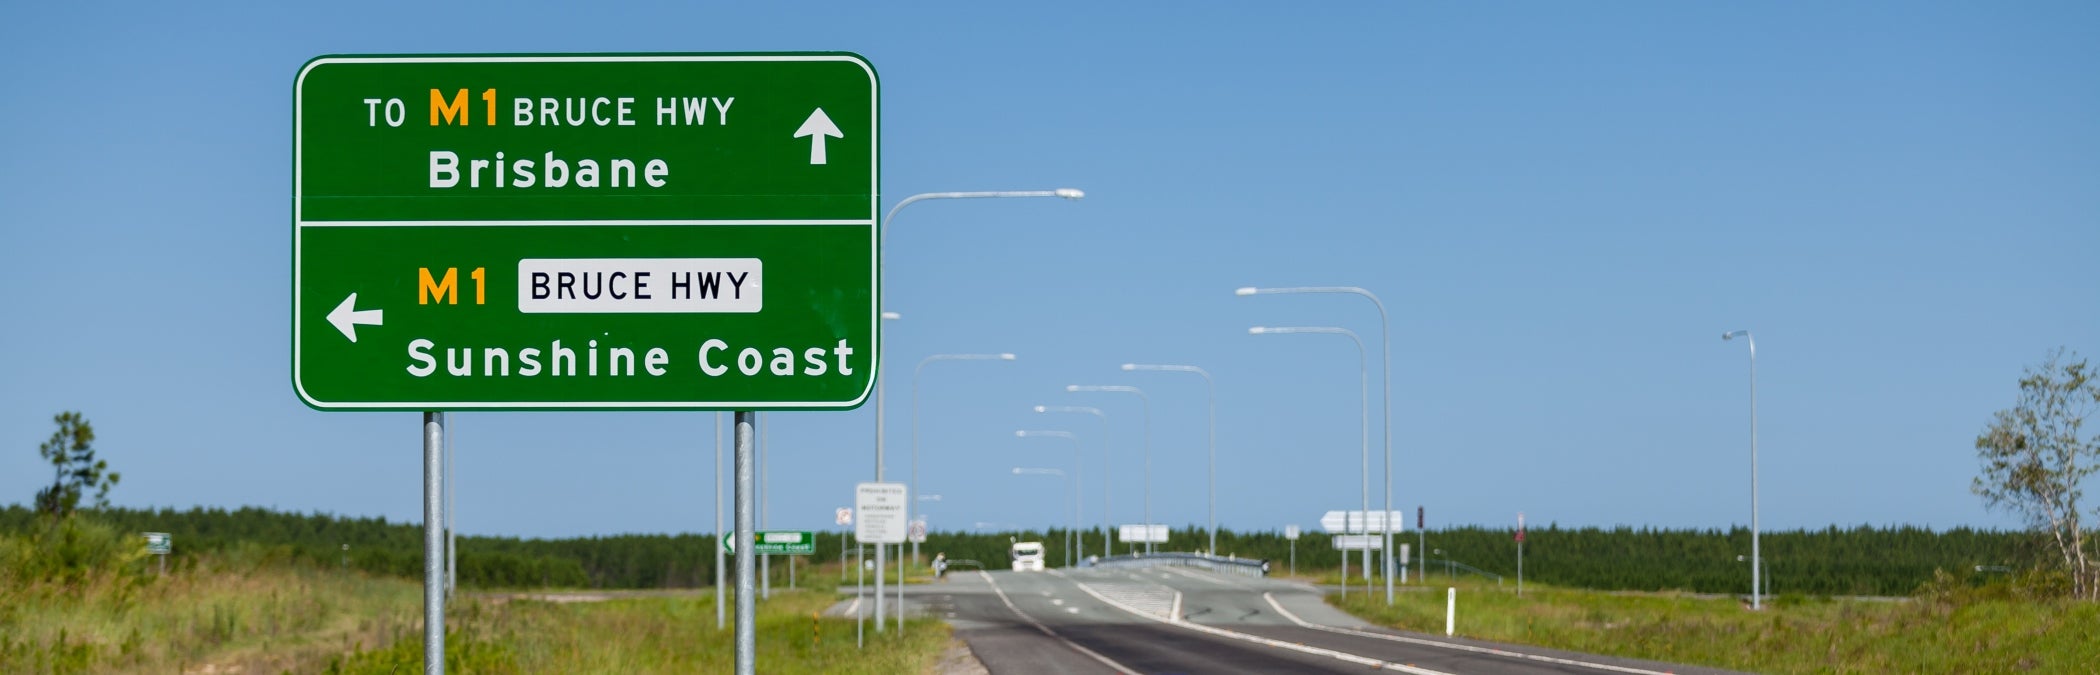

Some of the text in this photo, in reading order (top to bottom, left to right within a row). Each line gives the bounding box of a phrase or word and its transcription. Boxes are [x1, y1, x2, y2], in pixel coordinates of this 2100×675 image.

[363, 87, 735, 128] TO M1 BRUCE HWY
[429, 150, 669, 188] Brisbane
[418, 266, 749, 305] M1 BRUCE HWY
[406, 338, 854, 378] Sunshine Coast
